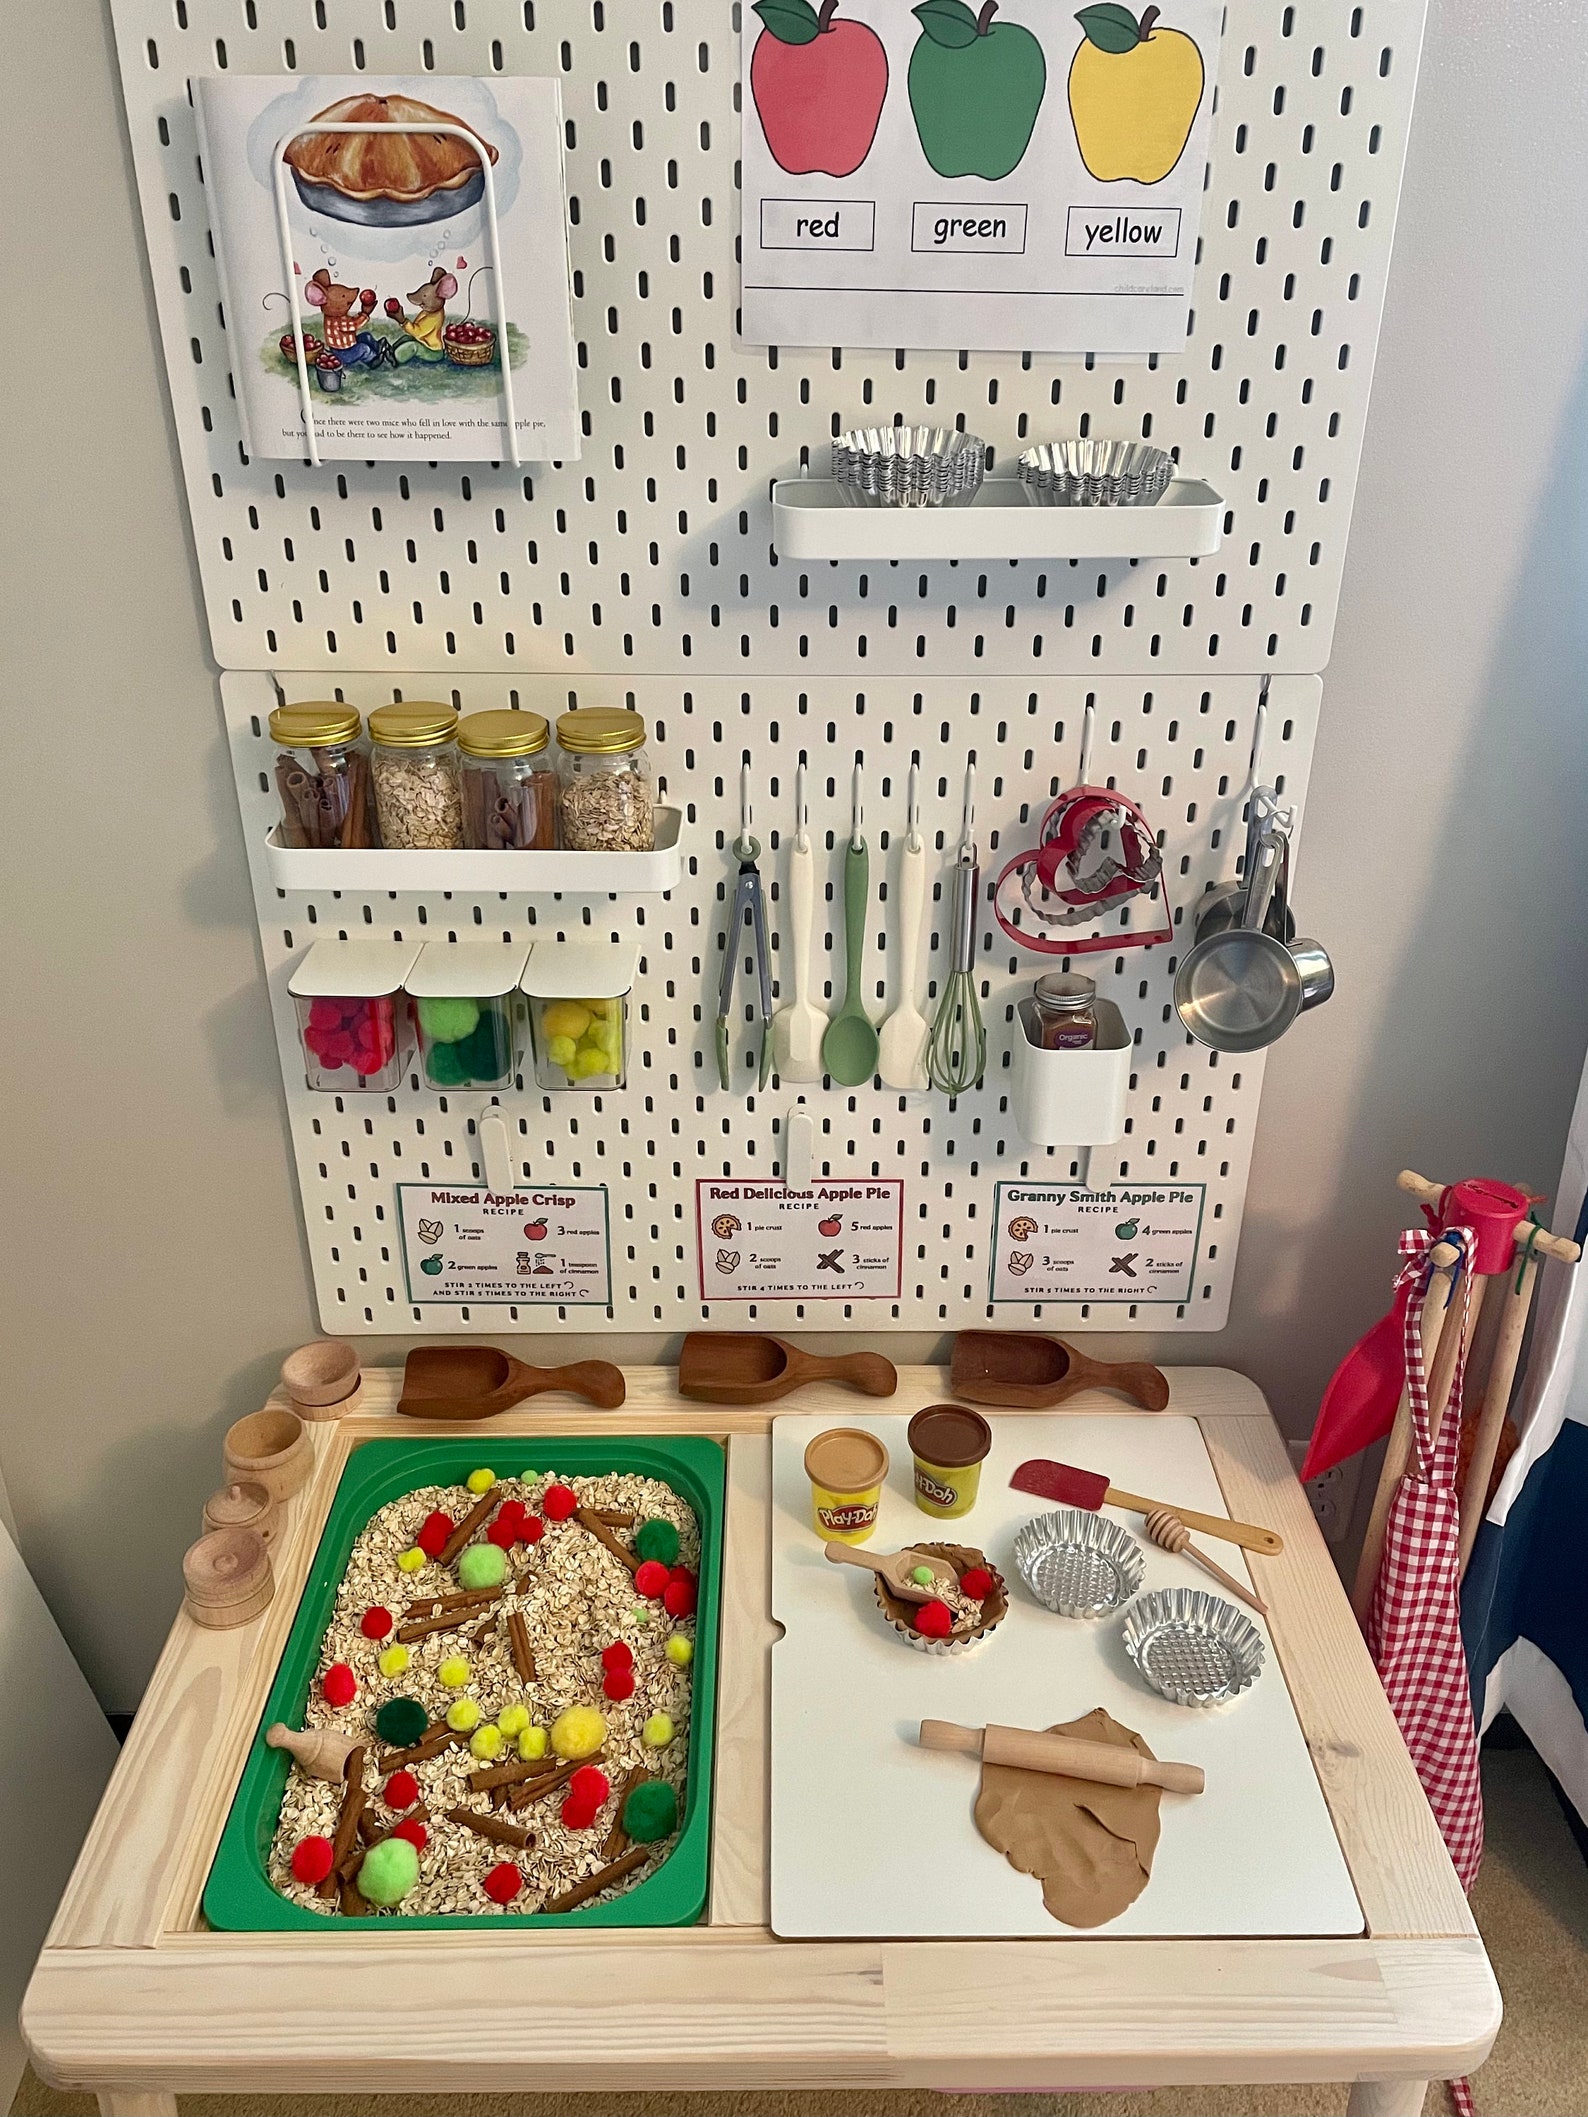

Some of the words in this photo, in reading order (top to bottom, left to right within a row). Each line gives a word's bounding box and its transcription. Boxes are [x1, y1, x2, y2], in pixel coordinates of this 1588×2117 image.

[796, 212, 840, 238] red
[934, 216, 1006, 244] green
[1084, 216, 1163, 250] yellow
[328, 418, 346, 426] there
[420, 418, 430, 427] fell
[442, 419, 456, 427] love
[459, 419, 475, 427] with
[477, 419, 490, 427] the
[514, 419, 530, 430] pple
[532, 420, 546, 430] pie,
[281, 428, 294, 437] but
[314, 429, 324, 438] ad
[336, 429, 346, 438] be
[347, 429, 365, 438] there
[390, 430, 405, 438] how
[1059, 1033, 1088, 1042] Organic
[710, 1188, 739, 1199] Red
[744, 1188, 814, 1199] Delicious
[818, 1188, 862, 1201] Apple
[866, 1188, 890, 1199] Pie
[1008, 1190, 1066, 1206] Granny
[1069, 1190, 1116, 1202] Smith
[1120, 1191, 1165, 1205] Apple
[1169, 1192, 1194, 1203] Pie
[431, 1192, 480, 1204] Mixed
[484, 1193, 529, 1207] Apple
[532, 1194, 576, 1208] Crisp
[454, 1224, 459, 1233] 1
[558, 1226, 565, 1236] 3
[747, 1222, 752, 1231] 1
[851, 1221, 859, 1231] 5
[1044, 1225, 1048, 1233] 1
[1142, 1225, 1150, 1235] 4
[560, 1259, 565, 1267] 1
[749, 1254, 757, 1262] 2
[852, 1254, 860, 1264] 3
[1042, 1256, 1050, 1265] 3
[1145, 1258, 1154, 1267] 2
[448, 1261, 456, 1270] 2
